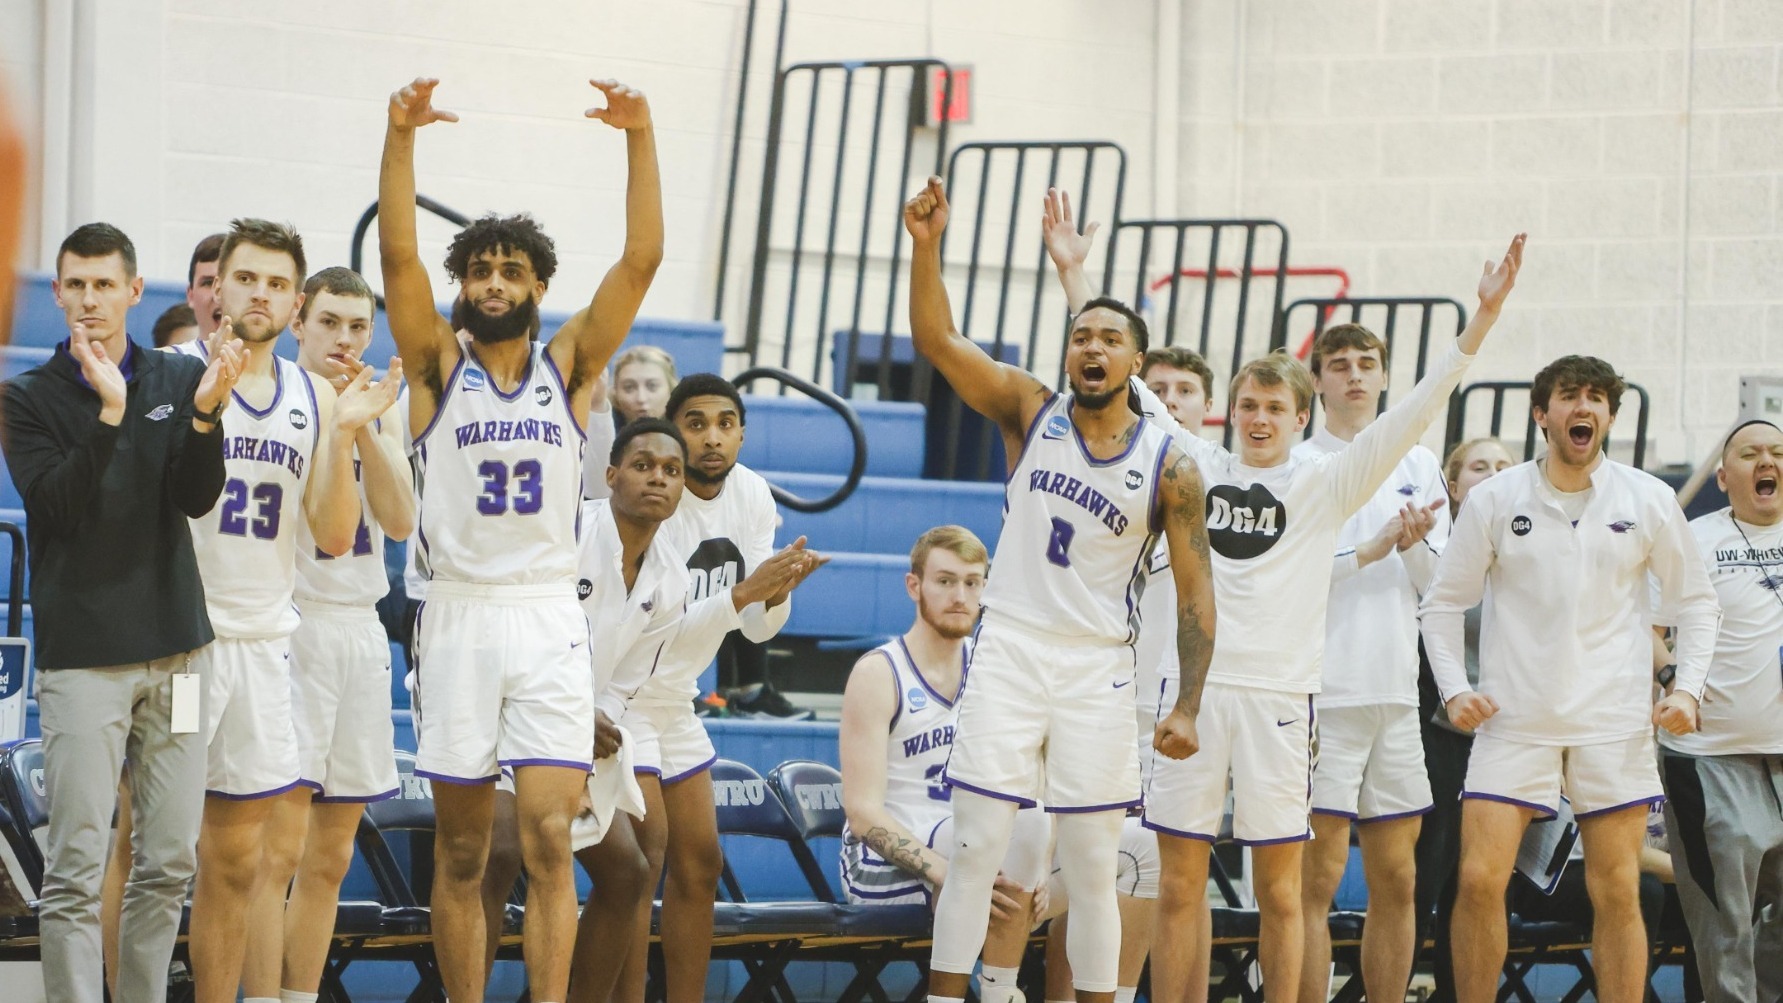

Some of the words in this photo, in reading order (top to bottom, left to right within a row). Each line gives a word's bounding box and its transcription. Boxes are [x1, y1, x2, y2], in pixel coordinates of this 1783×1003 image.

[455, 418, 562, 450] WARHAWKS
[218, 476, 283, 541] 23
[476, 458, 544, 517] 33
[1030, 469, 1128, 537] WARHAWKS
[1207, 495, 1278, 536] DG4
[1512, 520, 1531, 532] DG4
